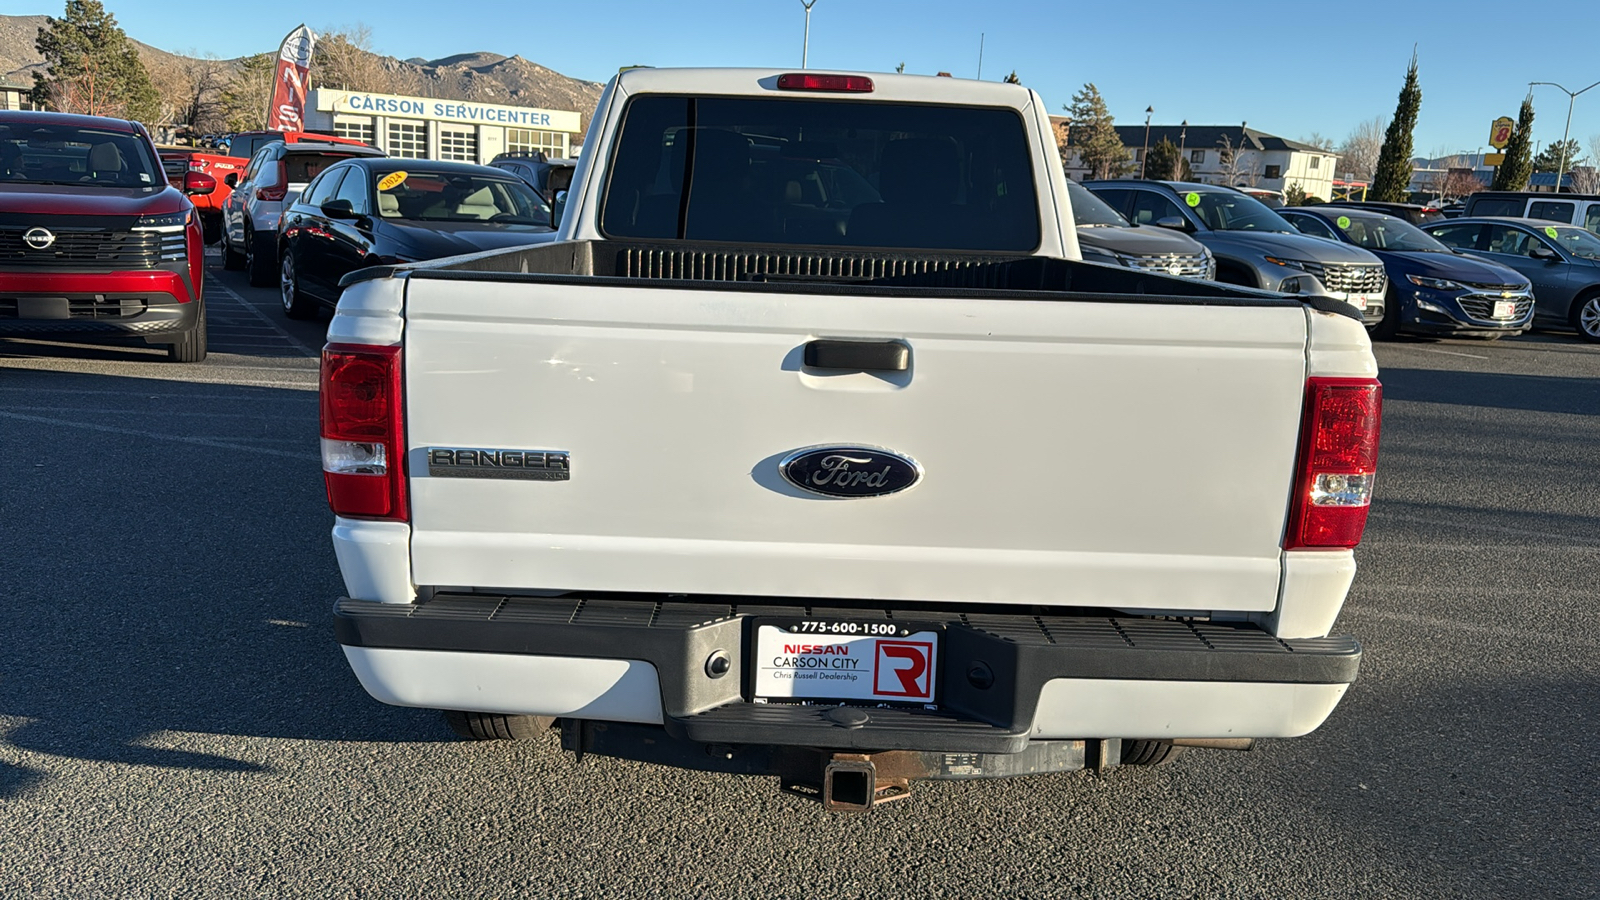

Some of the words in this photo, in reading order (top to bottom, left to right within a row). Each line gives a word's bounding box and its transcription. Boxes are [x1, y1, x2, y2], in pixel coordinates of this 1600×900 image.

[350, 96, 424, 115] CARSON
[434, 103, 550, 126] SERVICENTER
[1495, 127, 1510, 142] 8
[381, 172, 402, 188] 2024
[431, 449, 569, 469] RANGER
[545, 472, 568, 480] XLT
[812, 455, 892, 488] Ford
[801, 621, 896, 635] 775-600-1500
[784, 644, 849, 655] NISSAN
[773, 656, 828, 669] CARSON
[832, 659, 859, 669] CITY
[773, 671, 792, 679] Chris
[794, 671, 817, 680] Russell
[819, 672, 858, 682] Dealership
